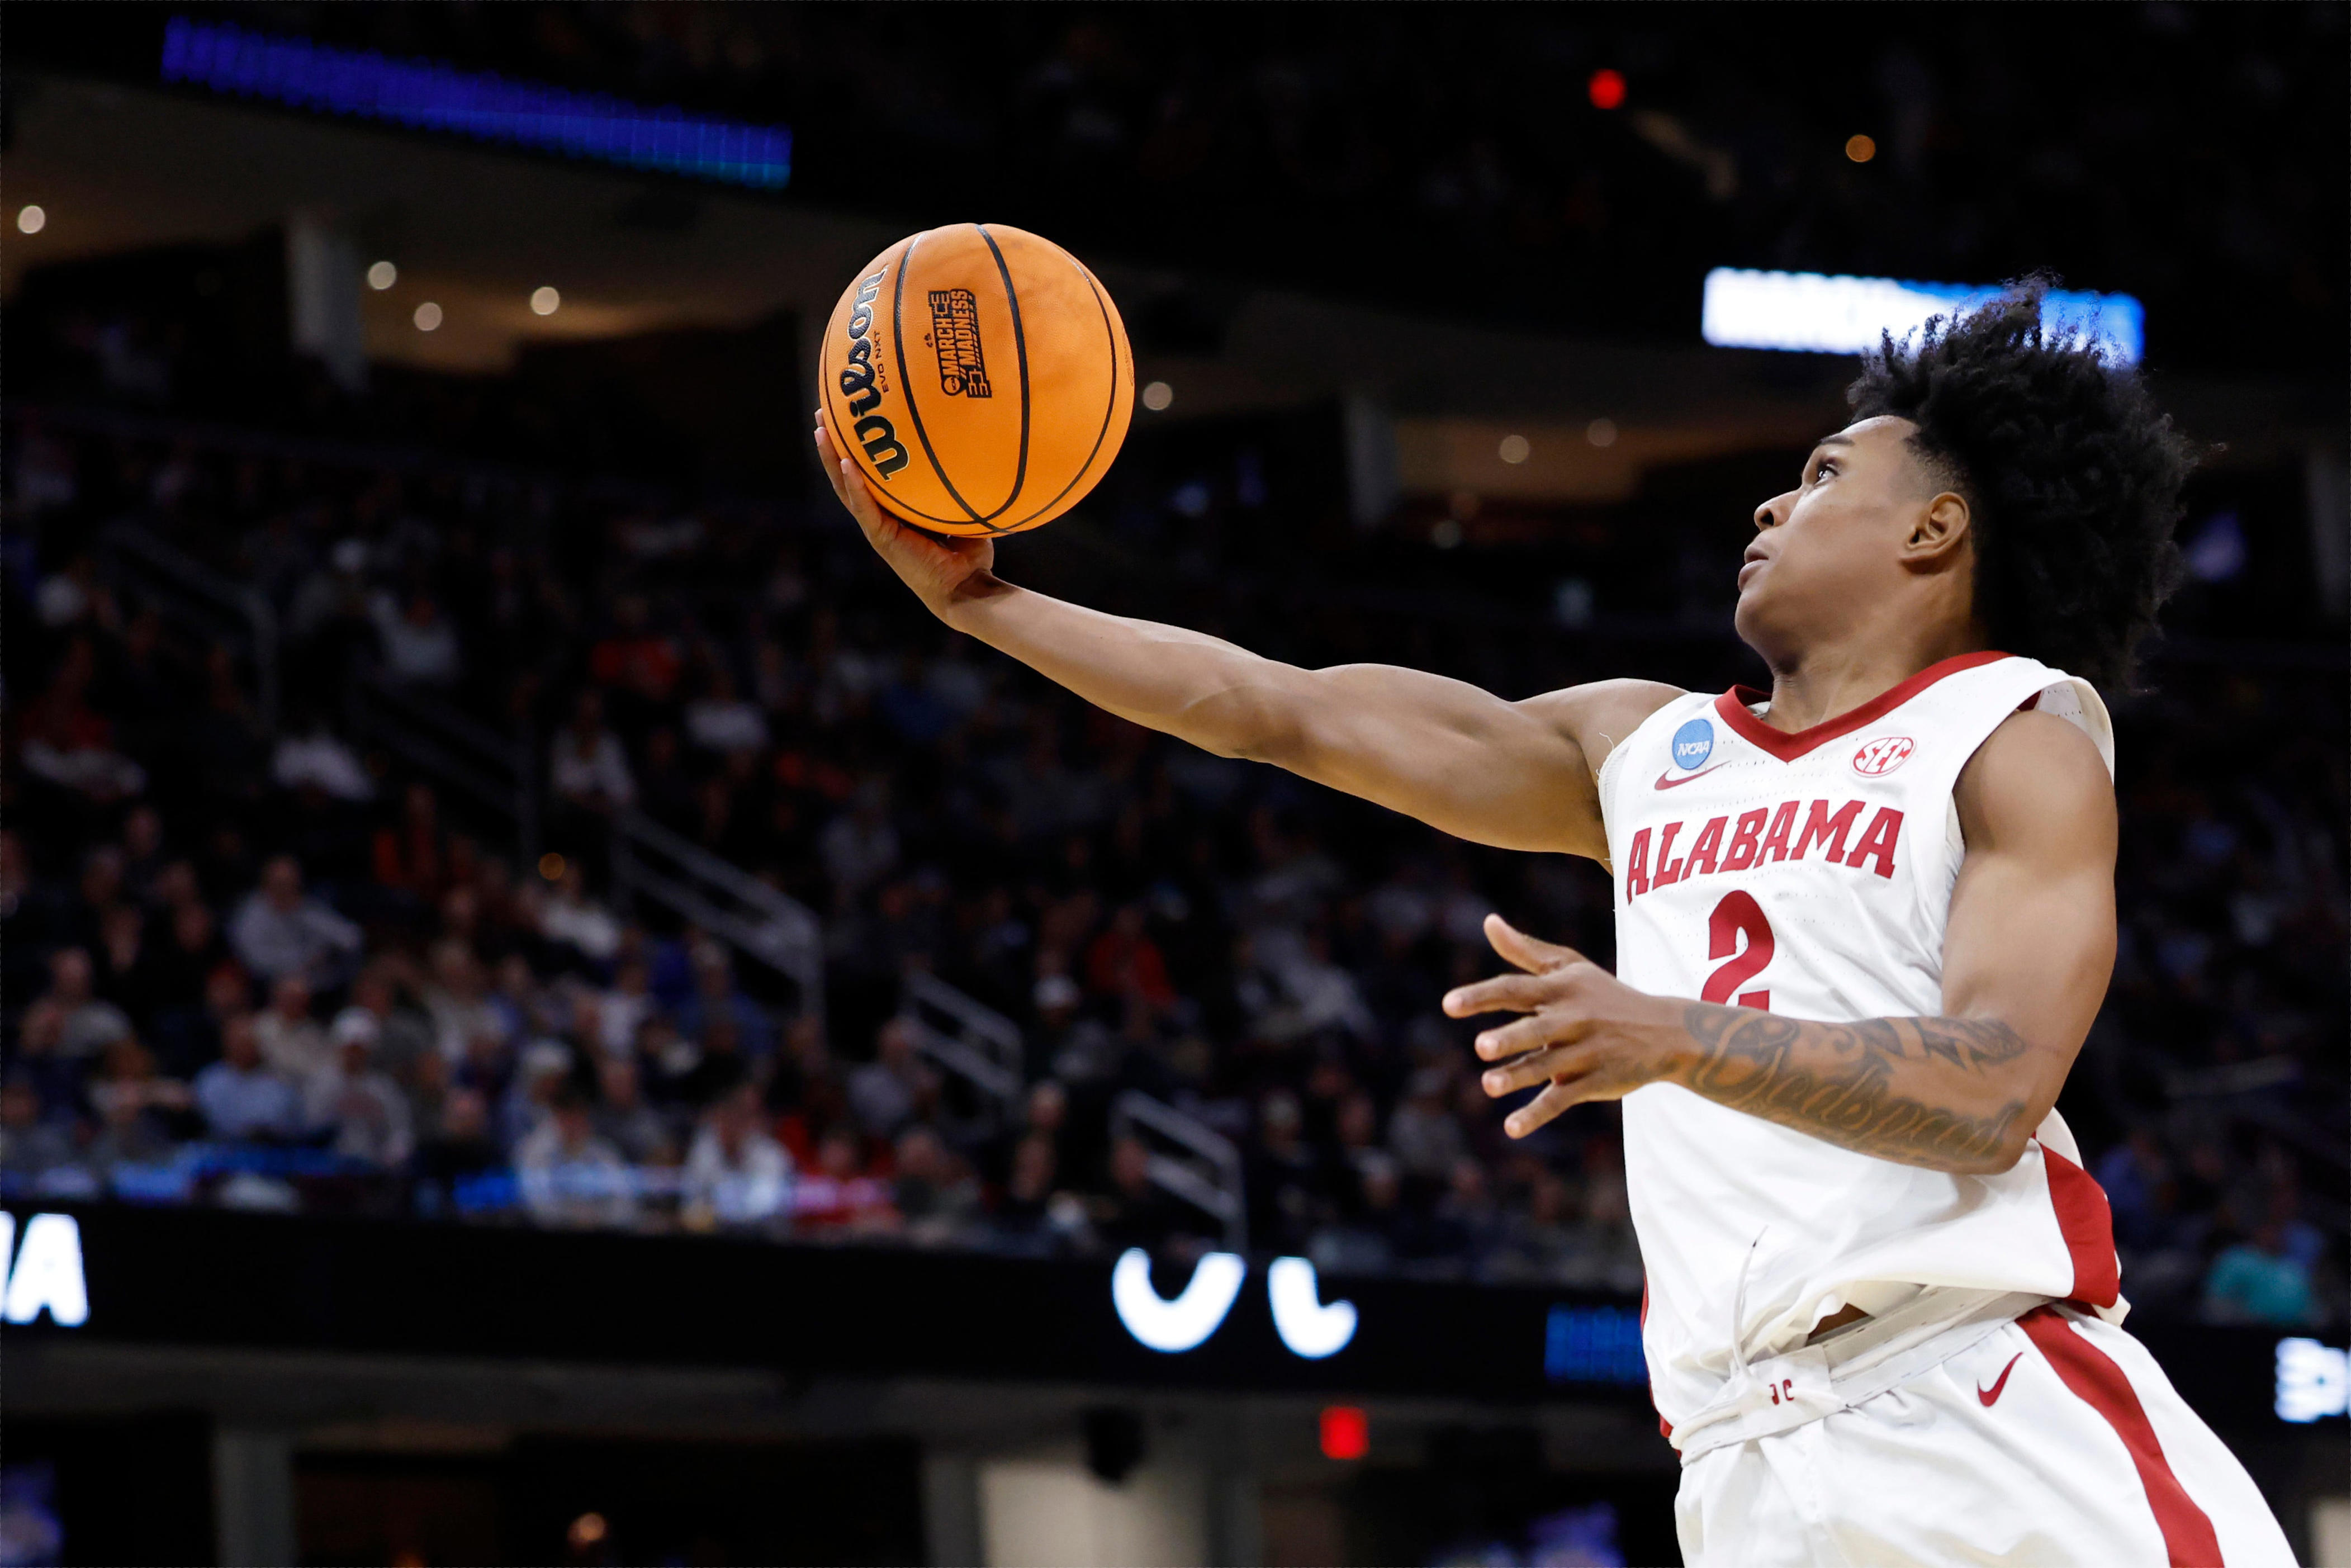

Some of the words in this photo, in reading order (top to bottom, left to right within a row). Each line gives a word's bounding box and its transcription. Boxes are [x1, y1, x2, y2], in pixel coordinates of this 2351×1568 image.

[874, 331, 882, 359] NXT
[935, 318, 960, 376] MARCH
[951, 290, 977, 366] MADNESS
[840, 264, 910, 482] Wilson
[877, 363, 889, 393] EVO
[1677, 740, 1710, 756] NCAA
[1853, 737, 1914, 774] SEC
[1627, 799, 1904, 907] ALABAMA
[1700, 889, 1775, 1013] 2
